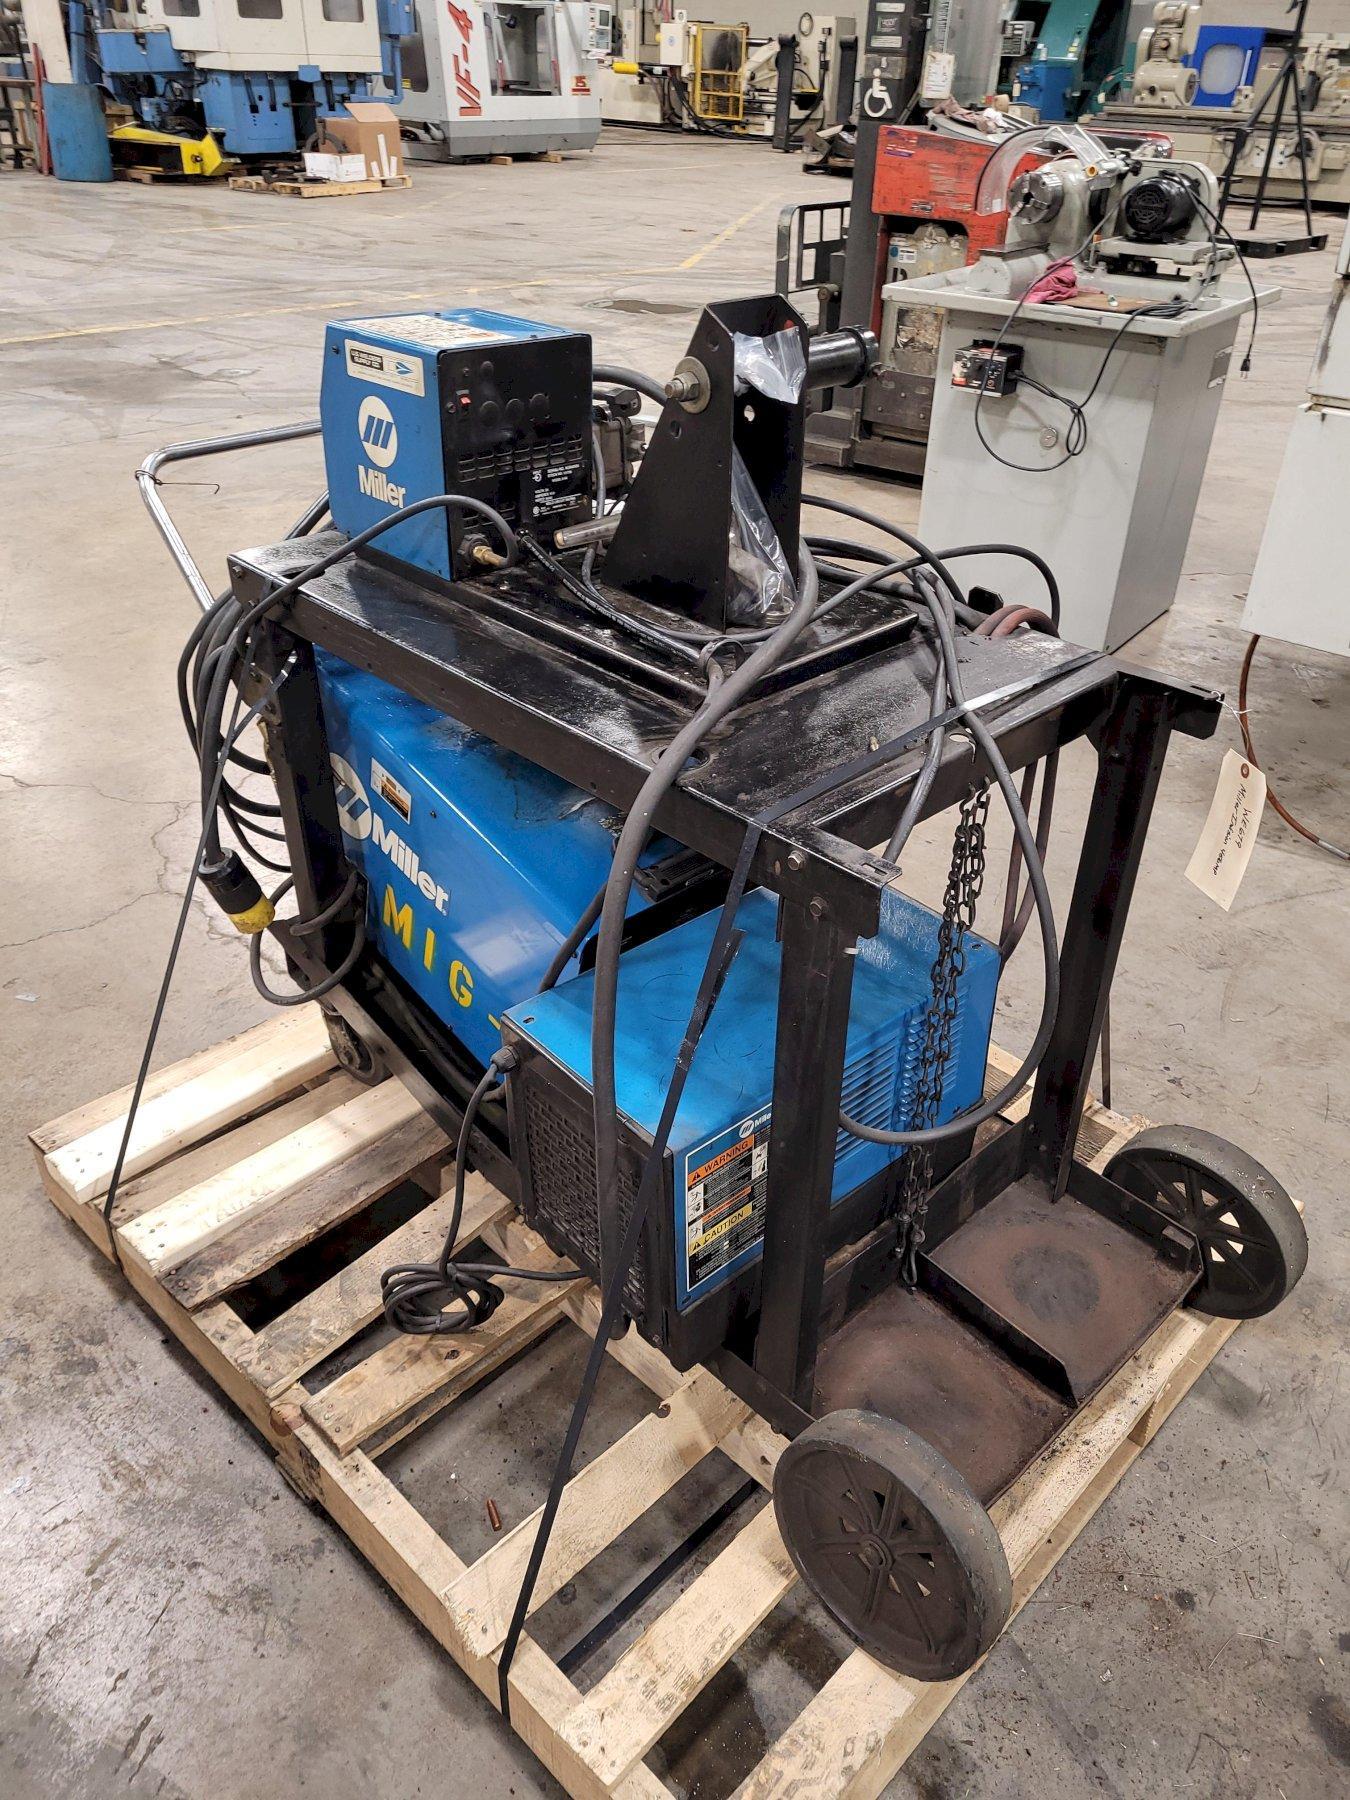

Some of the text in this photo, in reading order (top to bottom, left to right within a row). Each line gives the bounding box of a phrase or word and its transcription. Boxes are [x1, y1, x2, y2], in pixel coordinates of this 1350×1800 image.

[447, 0, 482, 117] VF-4
[357, 464, 406, 509] Miller
[371, 812, 449, 912] Miller
[704, 1140, 749, 1173] WARNING
[703, 1210, 744, 1244] CAUTION
